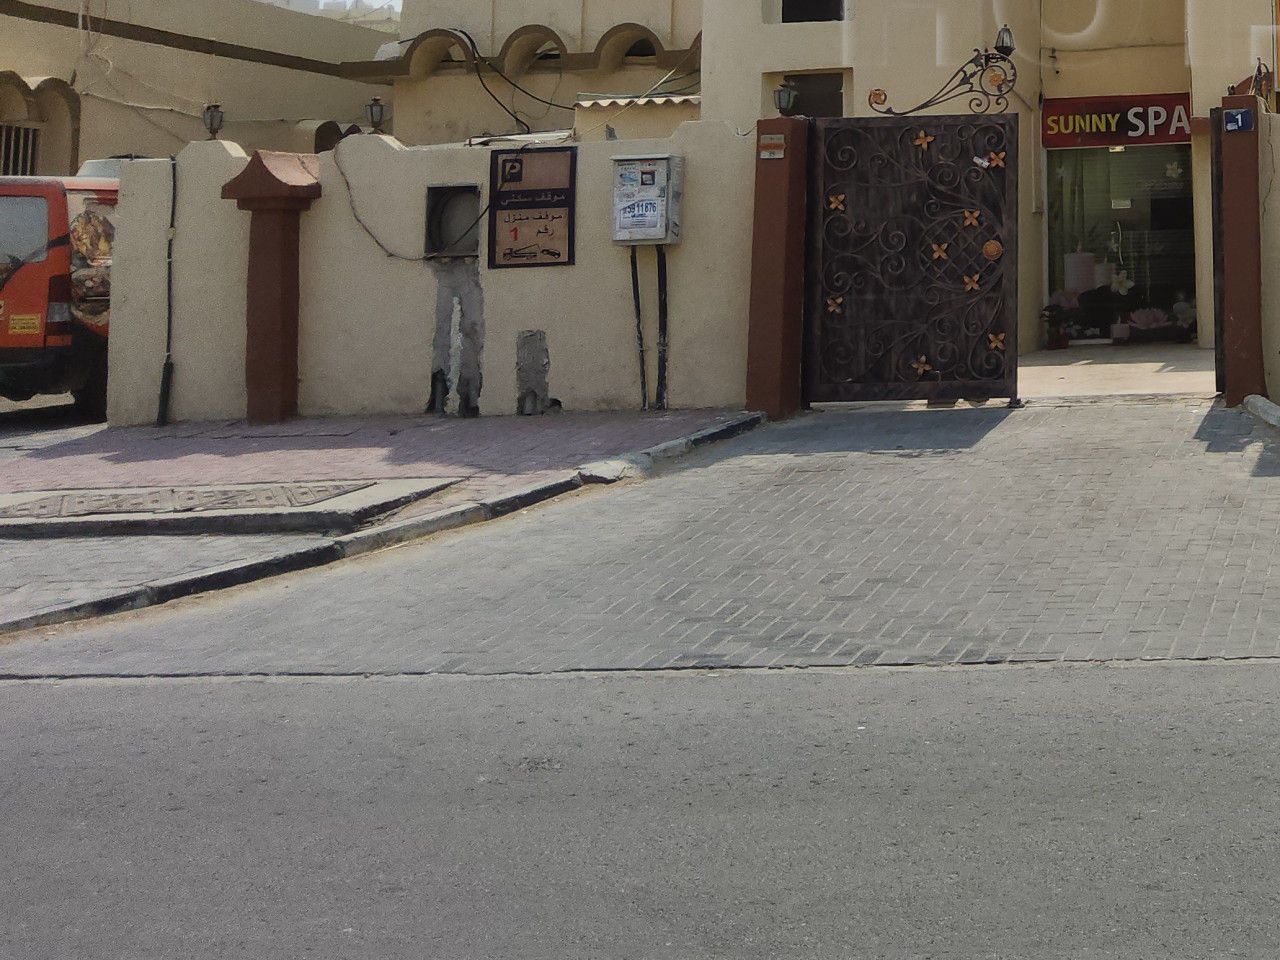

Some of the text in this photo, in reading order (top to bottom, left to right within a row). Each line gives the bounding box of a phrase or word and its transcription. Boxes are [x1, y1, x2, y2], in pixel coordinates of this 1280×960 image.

[1047, 104, 1192, 138] SUNNY SPA
[1235, 113, 1242, 127] 1
[510, 226, 519, 241] 1
